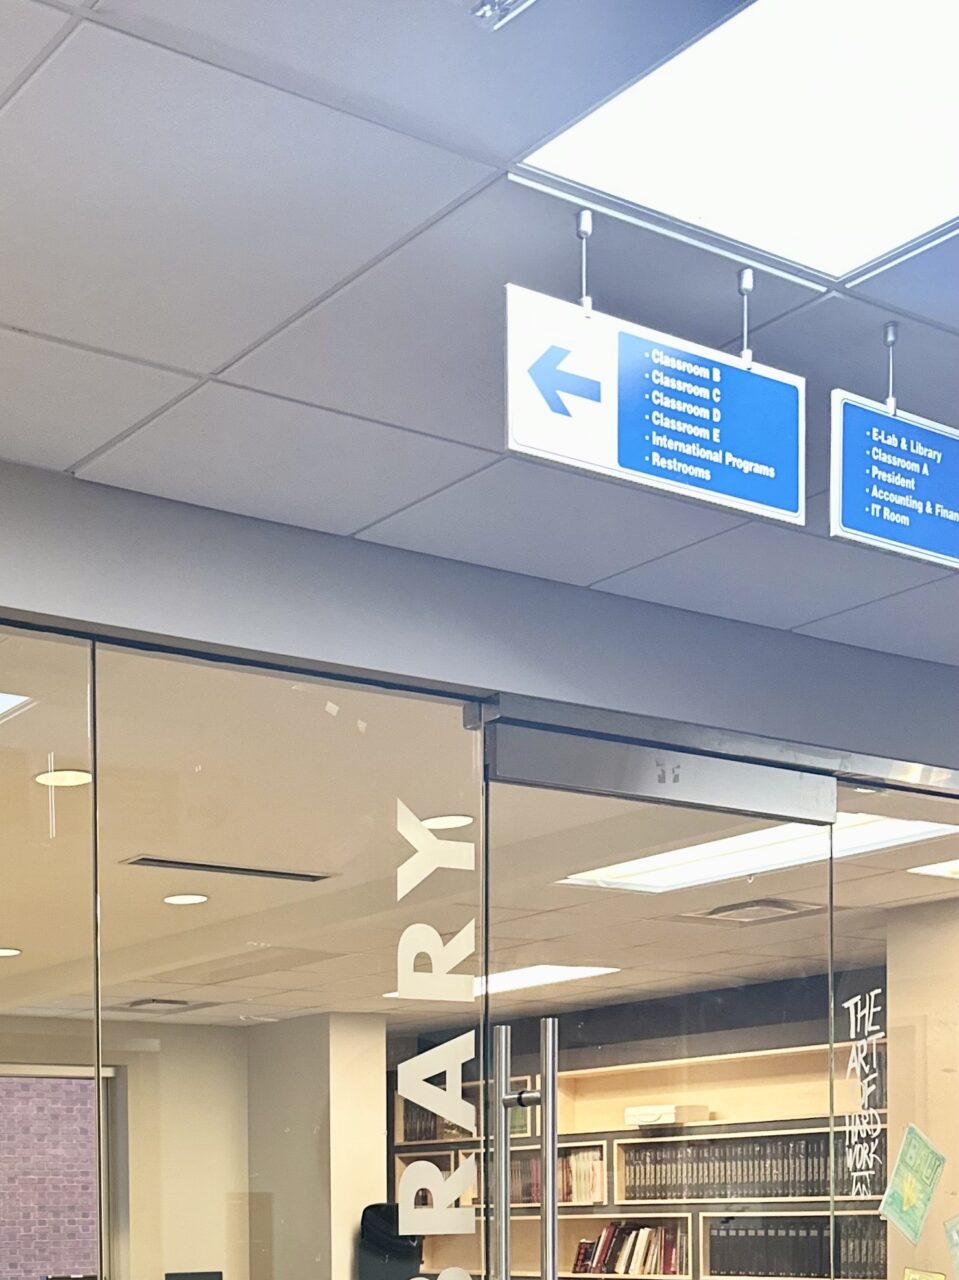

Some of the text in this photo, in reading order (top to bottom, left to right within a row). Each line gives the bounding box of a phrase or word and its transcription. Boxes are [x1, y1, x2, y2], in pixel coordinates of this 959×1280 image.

[651, 348, 721, 382] Classroom B
[651, 369, 721, 403] Classroom C
[651, 390, 721, 422] Classroom D
[651, 410, 721, 443] Classroom E
[652, 431, 775, 478] International Programs
[871, 446, 929, 476] Classroom A
[872, 427, 942, 463] E-Lab & Library
[652, 451, 711, 481] Restrooms
[871, 465, 915, 490] President
[871, 484, 923, 514] Accounting
[925, 500, 932, 514] &
[871, 503, 910, 526] IT Room
[842, 988, 882, 1040] THE
[846, 1031, 885, 1080] ART
[845, 1107, 882, 1146] HARD
[845, 1138, 883, 1172] WORK
